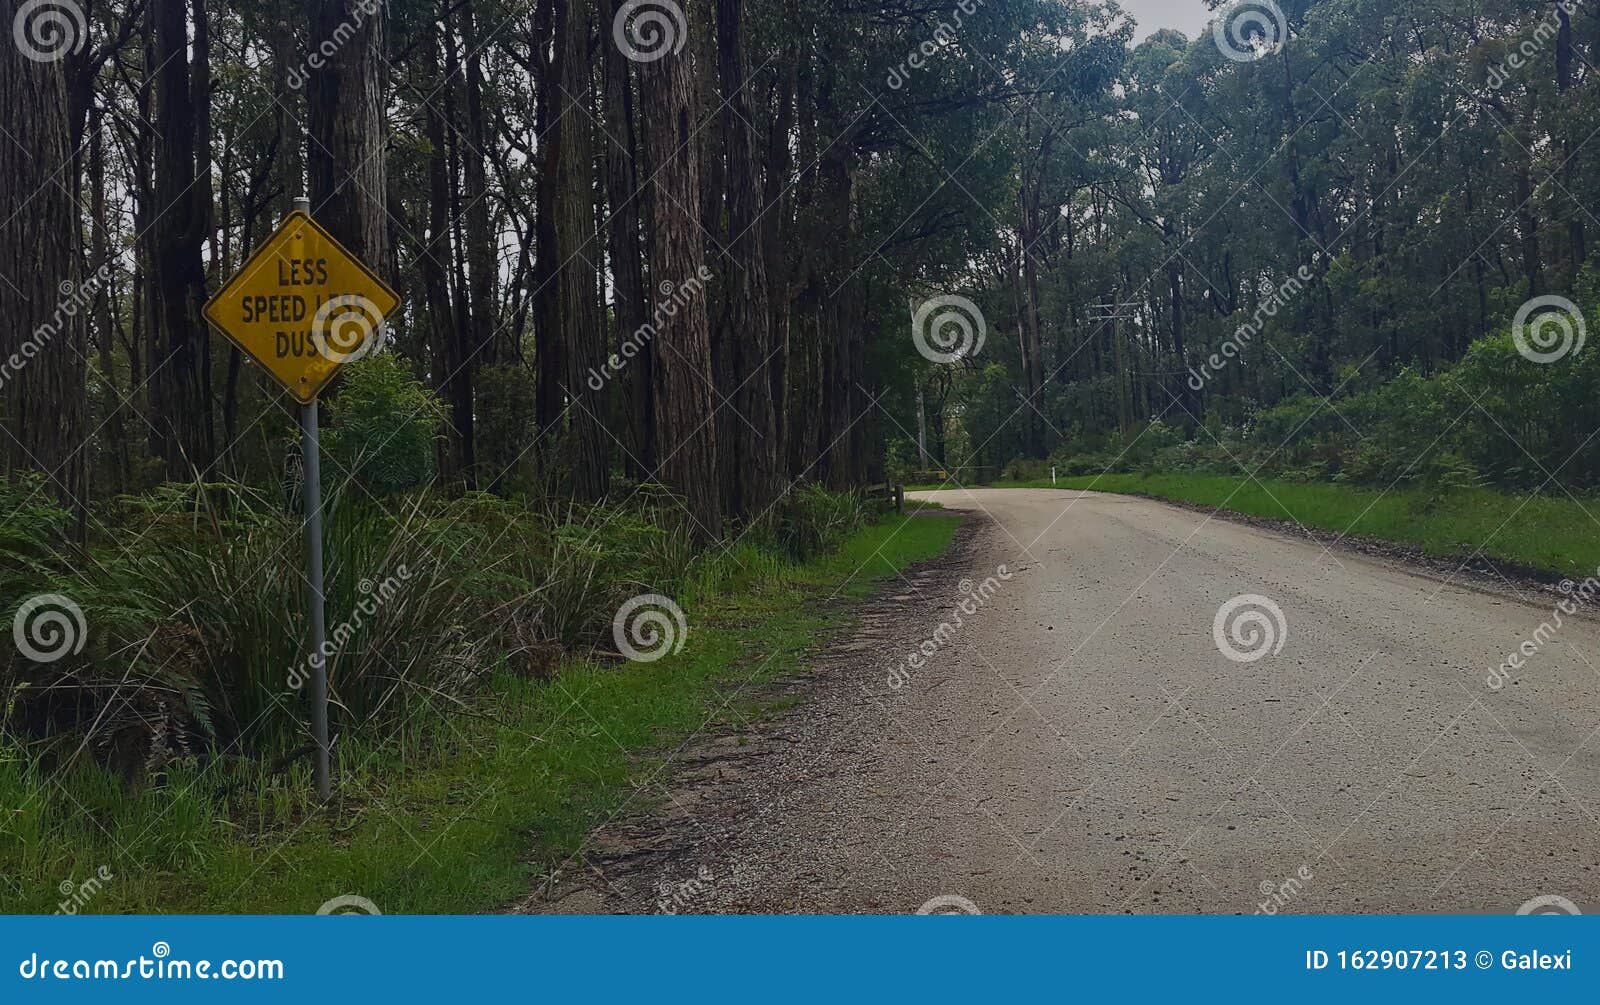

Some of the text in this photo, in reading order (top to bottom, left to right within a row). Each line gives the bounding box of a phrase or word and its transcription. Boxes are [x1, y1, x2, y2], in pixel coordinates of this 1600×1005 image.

[278, 258, 328, 286] LESS
[242, 294, 306, 323] SPEED
[276, 330, 333, 358] DUST
